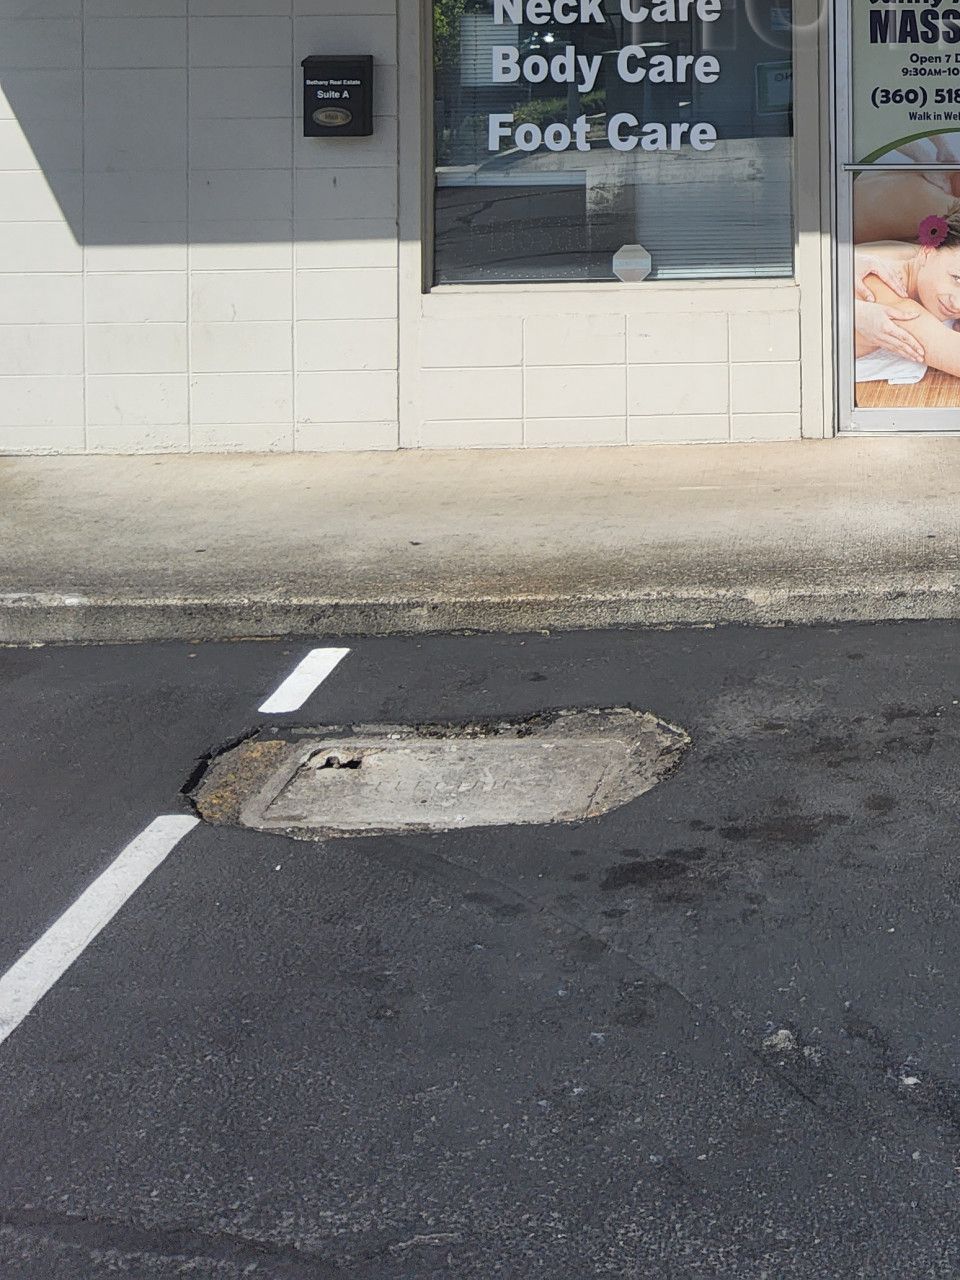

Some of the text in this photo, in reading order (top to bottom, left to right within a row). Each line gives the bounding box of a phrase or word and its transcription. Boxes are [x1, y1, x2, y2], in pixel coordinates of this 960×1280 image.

[492, 44, 720, 93] Body Care
[909, 53, 942, 66] Open
[944, 53, 952, 64] 7
[317, 90, 350, 98] Suite A
[871, 86, 928, 109] (360)
[908, 111, 932, 121] Walk
[933, 111, 942, 121] in
[487, 112, 718, 152] Foot Care
